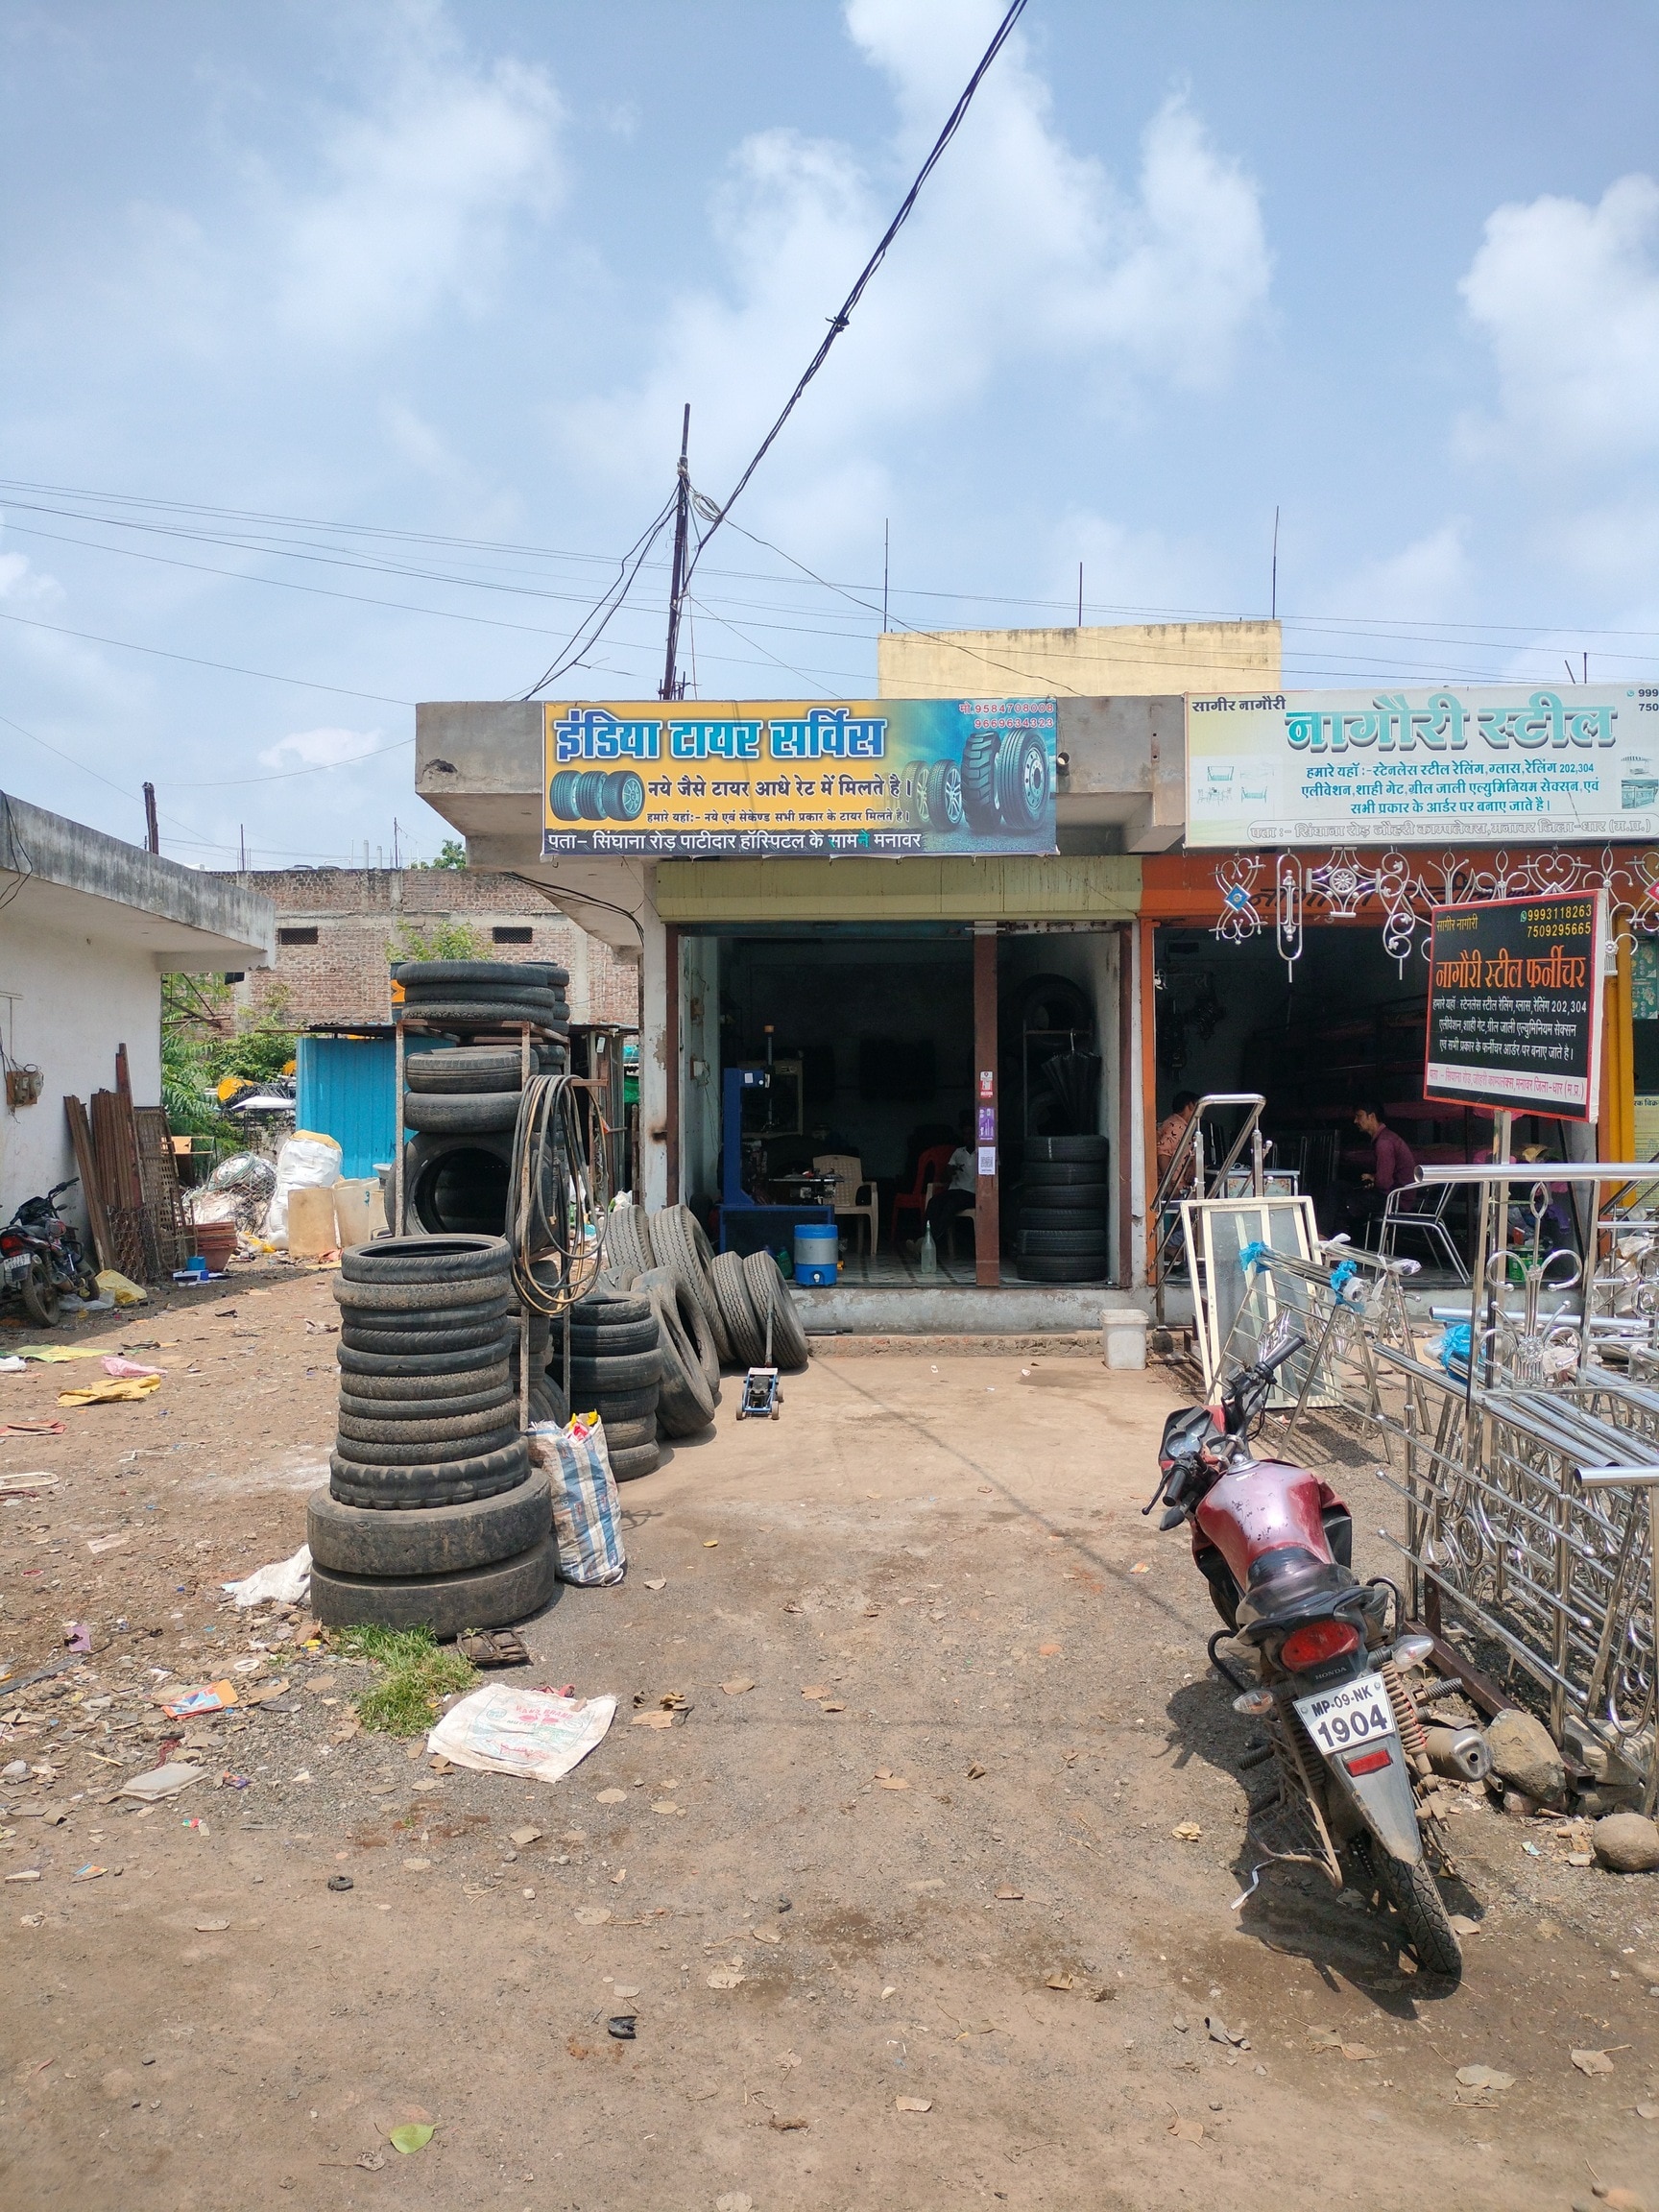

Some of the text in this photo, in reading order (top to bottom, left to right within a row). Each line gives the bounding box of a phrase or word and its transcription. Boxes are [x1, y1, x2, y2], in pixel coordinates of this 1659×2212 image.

[1191, 695, 1286, 711] सागीर नागौरी
[974, 718, 1053, 729] 9669634323
[1285, 690, 1618, 753] नागौरी स्टील
[554, 708, 888, 762] इंडिया टायर सर्विस
[1307, 763, 1334, 778] हमारे
[1373, 761, 1417, 777] स्टेनलेस
[1420, 760, 1450, 776] स्टील
[1525, 759, 1556, 774] रेलिंग
[1559, 763, 1594, 775] 202,304
[648, 775, 672, 797] नये
[678, 775, 707, 797] जैसे
[711, 781, 750, 797] टायर
[755, 775, 790, 797] आधे
[796, 774, 815, 797] रेट
[821, 774, 836, 796] में
[839, 774, 885, 796] मिलते
[1356, 781, 1382, 797] शाही
[1436, 779, 1466, 794] जाली
[1469, 779, 1537, 797] एल्युमिनियम
[1584, 777, 1599, 793] एवं
[1351, 799, 1375, 814] सभी
[1378, 803, 1409, 814] प्रकार
[1412, 799, 1423, 813] के
[1427, 798, 1456, 812] आर्डर
[1459, 802, 1474, 812] पर
[1477, 801, 1506, 814] बनाए
[1509, 797, 1533, 811] जाते
[647, 809, 669, 823] हमारे
[704, 810, 718, 822] नये
[722, 809, 736, 824] एवं
[739, 809, 770, 823] सेकेण्ड
[775, 809, 795, 823] सभी
[798, 812, 824, 823] प्रकार
[827, 809, 837, 822] के
[839, 812, 862, 822] टायर
[865, 809, 893, 823] मिलते
[1250, 827, 1277, 838] पता
[1295, 823, 1344, 838] सिंघाना
[1491, 821, 1535, 833] मनावर
[592, 830, 646, 850] सिंघाना
[681, 830, 736, 850] पाटीदार
[740, 830, 805, 850] हॉस्पिटल
[809, 830, 824, 848] के
[829, 830, 870, 849] सामने
[874, 833, 922, 848] मनावर
[1527, 904, 1592, 922] 9993118263
[1527, 922, 1591, 937] 7509295665
[1436, 949, 1482, 988] नागौरी
[1485, 948, 1523, 988] स्टील
[1527, 945, 1586, 988] फर्नीचर
[1460, 996, 1481, 1010] स्टेनलेस
[1482, 996, 1497, 1011] स्टील
[1551, 1000, 1587, 1016] 202,304
[1501, 1018, 1515, 1033] जाली
[1517, 1019, 1552, 1038] एल्युमिनियम
[1554, 1020, 1576, 1036] सेक्सन
[1448, 1037, 1459, 1050] सभी
[1459, 1041, 1475, 1052] प्रकार
[1476, 1038, 1481, 1052] के
[1503, 1040, 1520, 1056] आर्डर
[1522, 1045, 1529, 1056] पर
[1531, 1046, 1547, 1060] बनाए
[1549, 1044, 1563, 1059] जाते
[1314, 1666, 1347, 1681] HONDA
[1310, 1685, 1373, 1718] MP-09-NK
[1317, 1703, 1387, 1748] 1904
